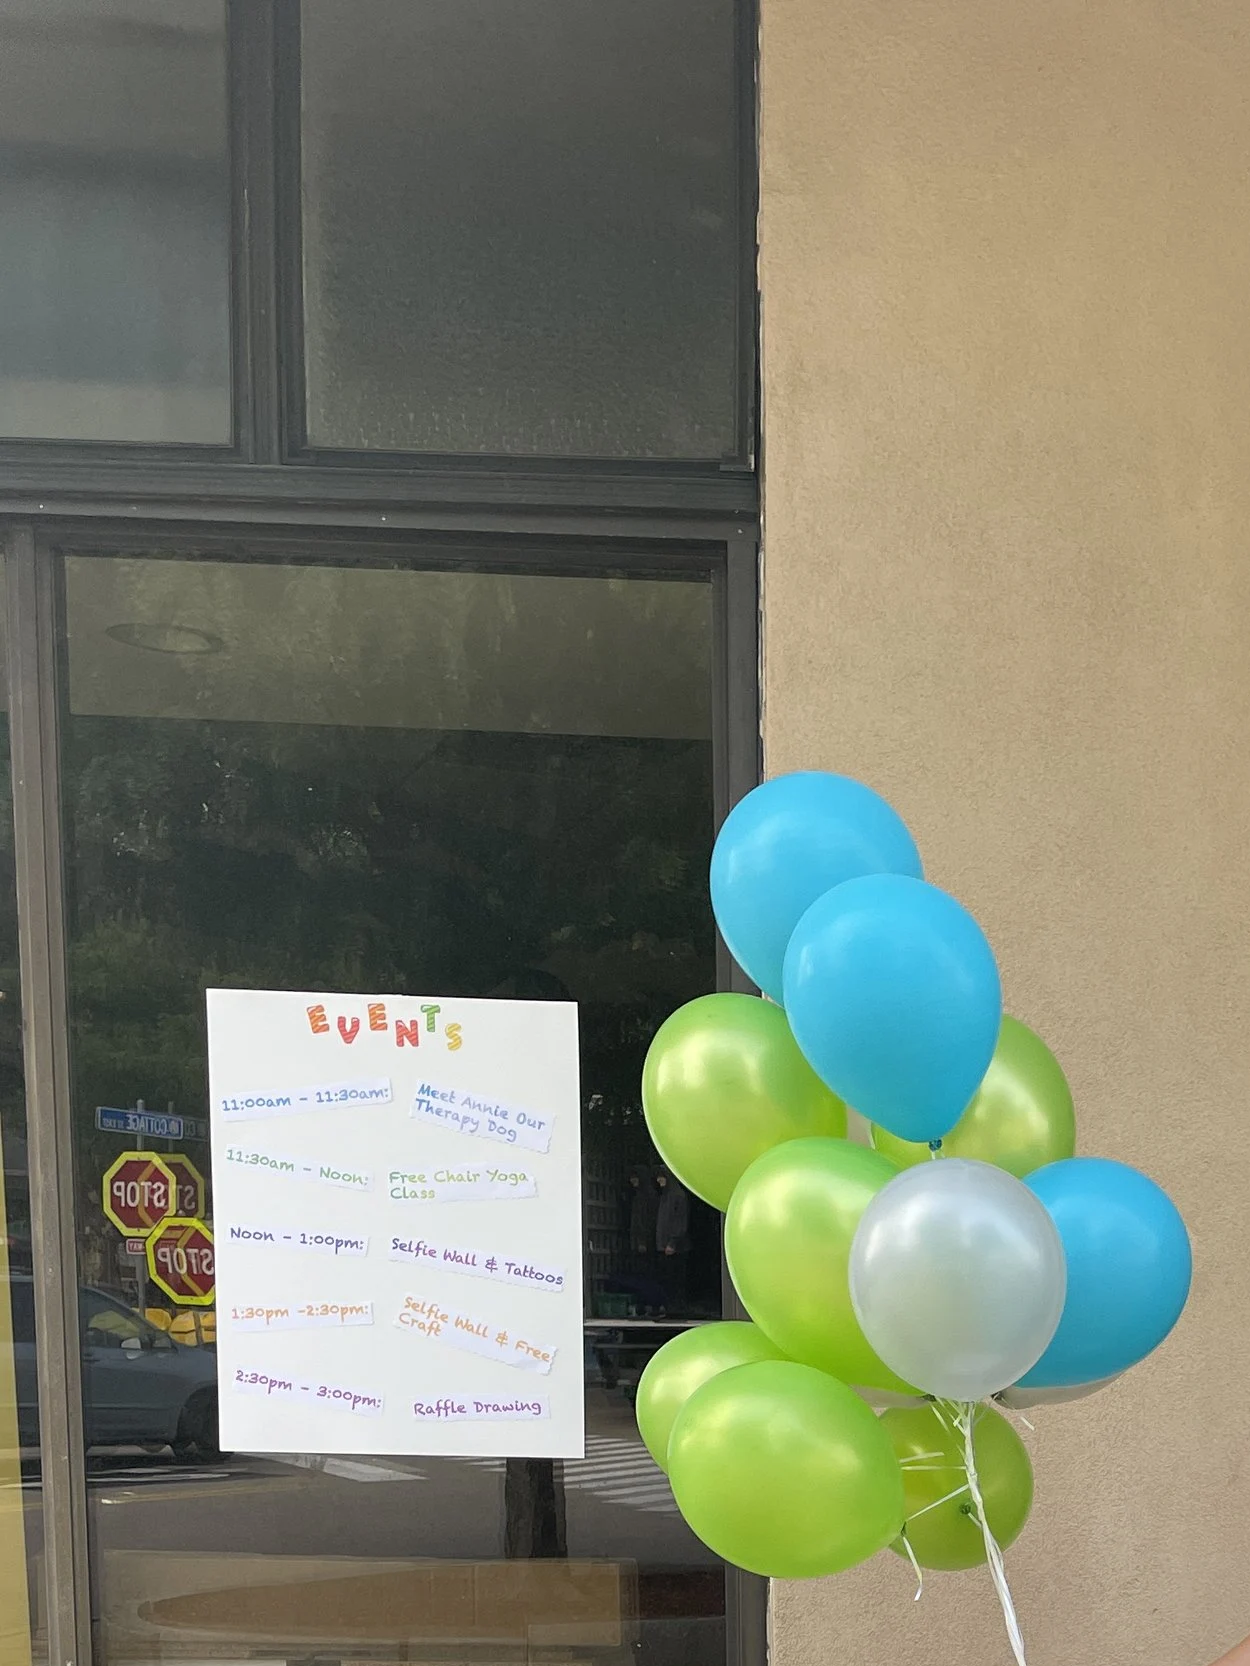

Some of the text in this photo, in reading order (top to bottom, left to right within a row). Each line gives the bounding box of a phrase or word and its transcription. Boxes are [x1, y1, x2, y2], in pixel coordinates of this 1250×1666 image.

[306, 1003, 462, 1051] EVENTS
[222, 1095, 292, 1112] 11:00am
[316, 1086, 390, 1103] 11:30am:
[417, 1083, 546, 1131] Meet Annie Our
[415, 1098, 518, 1142] Therapy Dog
[226, 1149, 295, 1172] 11:30am
[320, 1167, 369, 1186] Noon:
[389, 1170, 528, 1187] Free Chair Yoga
[390, 1187, 435, 1200] Class
[230, 1227, 275, 1242] Noon
[300, 1232, 364, 1254] 1:00pm:
[392, 1237, 564, 1285] Selfie Wall & Tattoos
[232, 1307, 289, 1324] 1:30pm
[399, 1312, 442, 1337] Craft
[405, 1297, 550, 1362] Selfie Wall & Free
[236, 1370, 292, 1394] 2:30pm
[317, 1386, 381, 1409] 3:00pm:
[414, 1400, 541, 1416] Raffle Drawing
